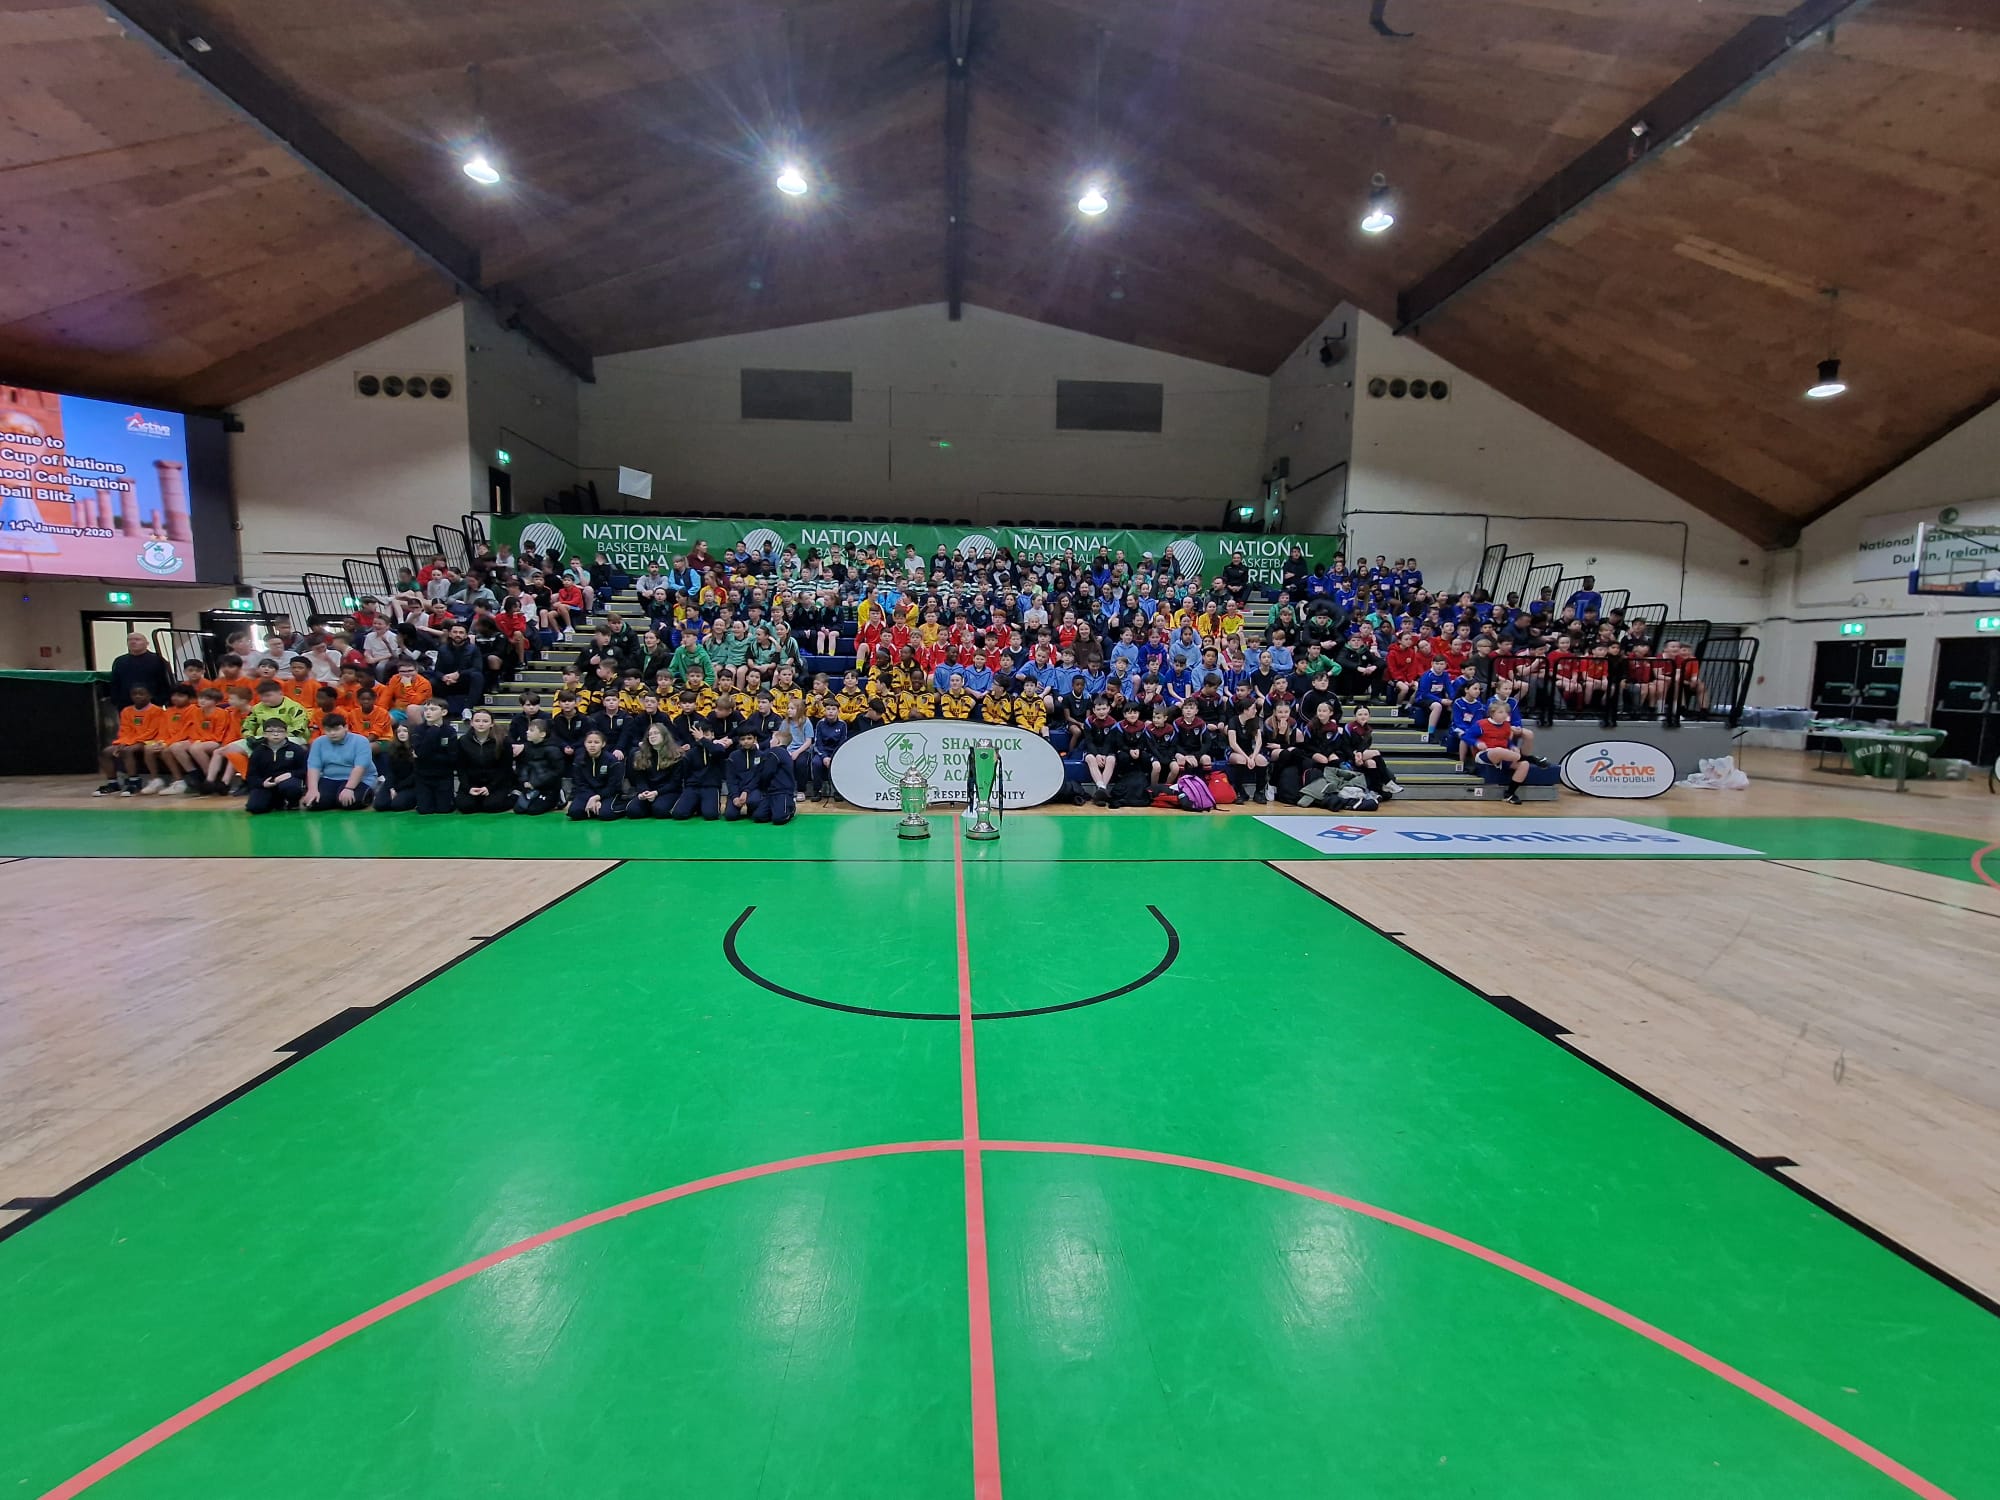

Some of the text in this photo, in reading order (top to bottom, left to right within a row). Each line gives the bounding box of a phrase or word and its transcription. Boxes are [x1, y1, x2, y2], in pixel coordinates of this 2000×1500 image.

[46, 437, 64, 449] to
[1, 449, 125, 473] Cup of Nations
[0, 468, 129, 491] ool Celebration
[37, 489, 75, 503] Blitz
[33, 523, 82, 537] January
[85, 528, 113, 538] 2026
[582, 523, 687, 541] NATIONAL
[801, 529, 903, 547] NATIONAL
[597, 542, 672, 553] BASKETBALL
[1014, 535, 1113, 551] NATIONAL
[1859, 534, 1914, 552] National
[1246, 568, 1284, 585] REN
[1590, 760, 1655, 776] Active
[1622, 776, 1656, 784] DUBLIN
[1394, 831, 1681, 843] Domino's
